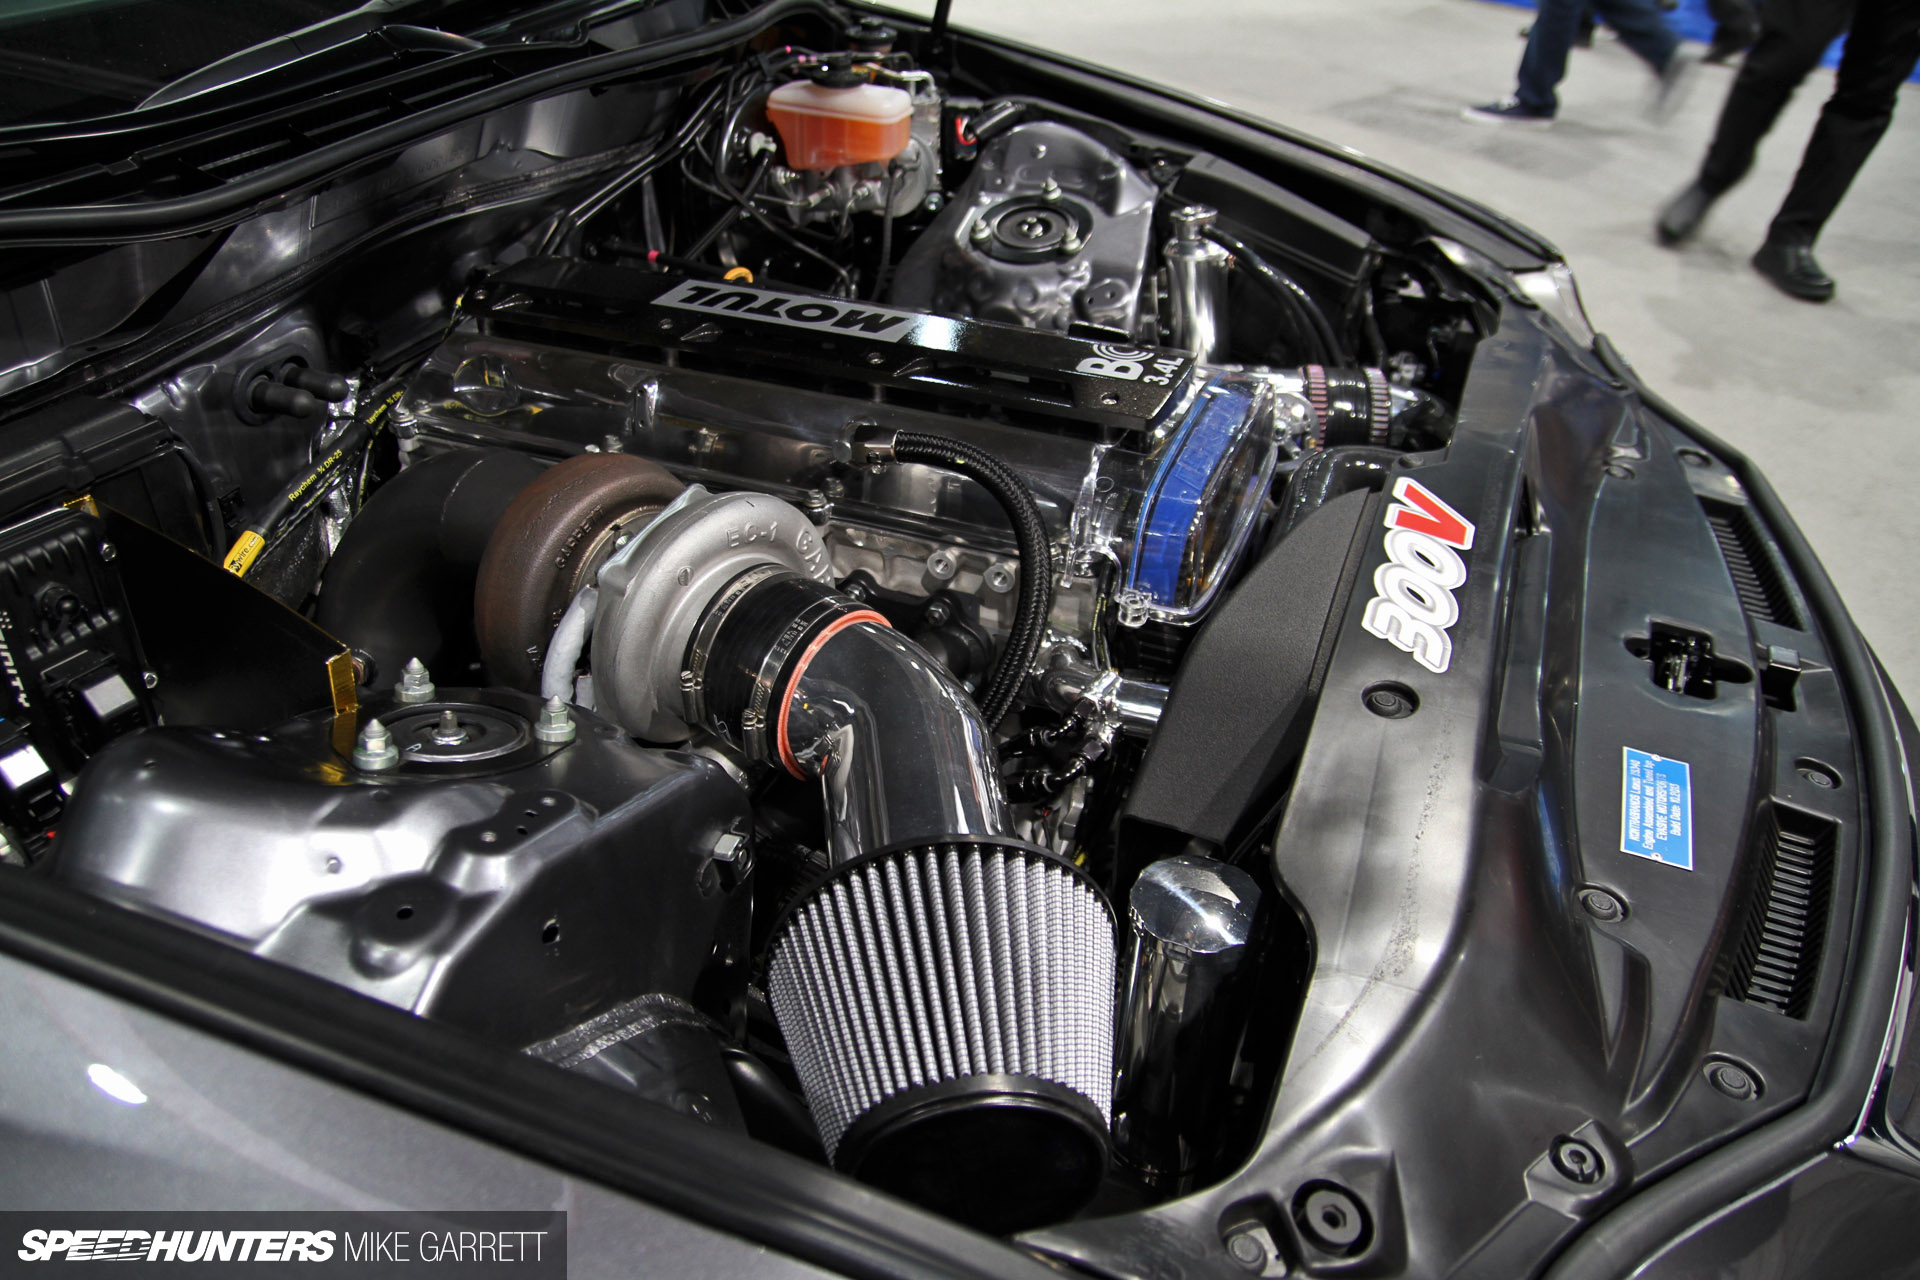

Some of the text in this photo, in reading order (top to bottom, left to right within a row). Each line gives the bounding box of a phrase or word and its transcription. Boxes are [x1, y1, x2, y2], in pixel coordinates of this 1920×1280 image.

[677, 286, 910, 334] MOTUL
[1143, 357, 1184, 386] 3.4L
[288, 474, 317, 501] Raychem
[323, 449, 342, 469] DR-25
[555, 504, 604, 569] GARRETT
[726, 521, 778, 549] EC-1
[1361, 477, 1476, 673] 300V
[1629, 777, 1641, 794] Lexus
[1643, 768, 1655, 784] Tuned
[1643, 784, 1655, 797] and
[1628, 794, 1641, 842] KONTRABRANDS
[1643, 796, 1655, 829] Assembled
[1655, 772, 1668, 840] EVASIVE MOTORSPORTS
[1642, 829, 1656, 850] Engine
[1670, 820, 1682, 837] Build
